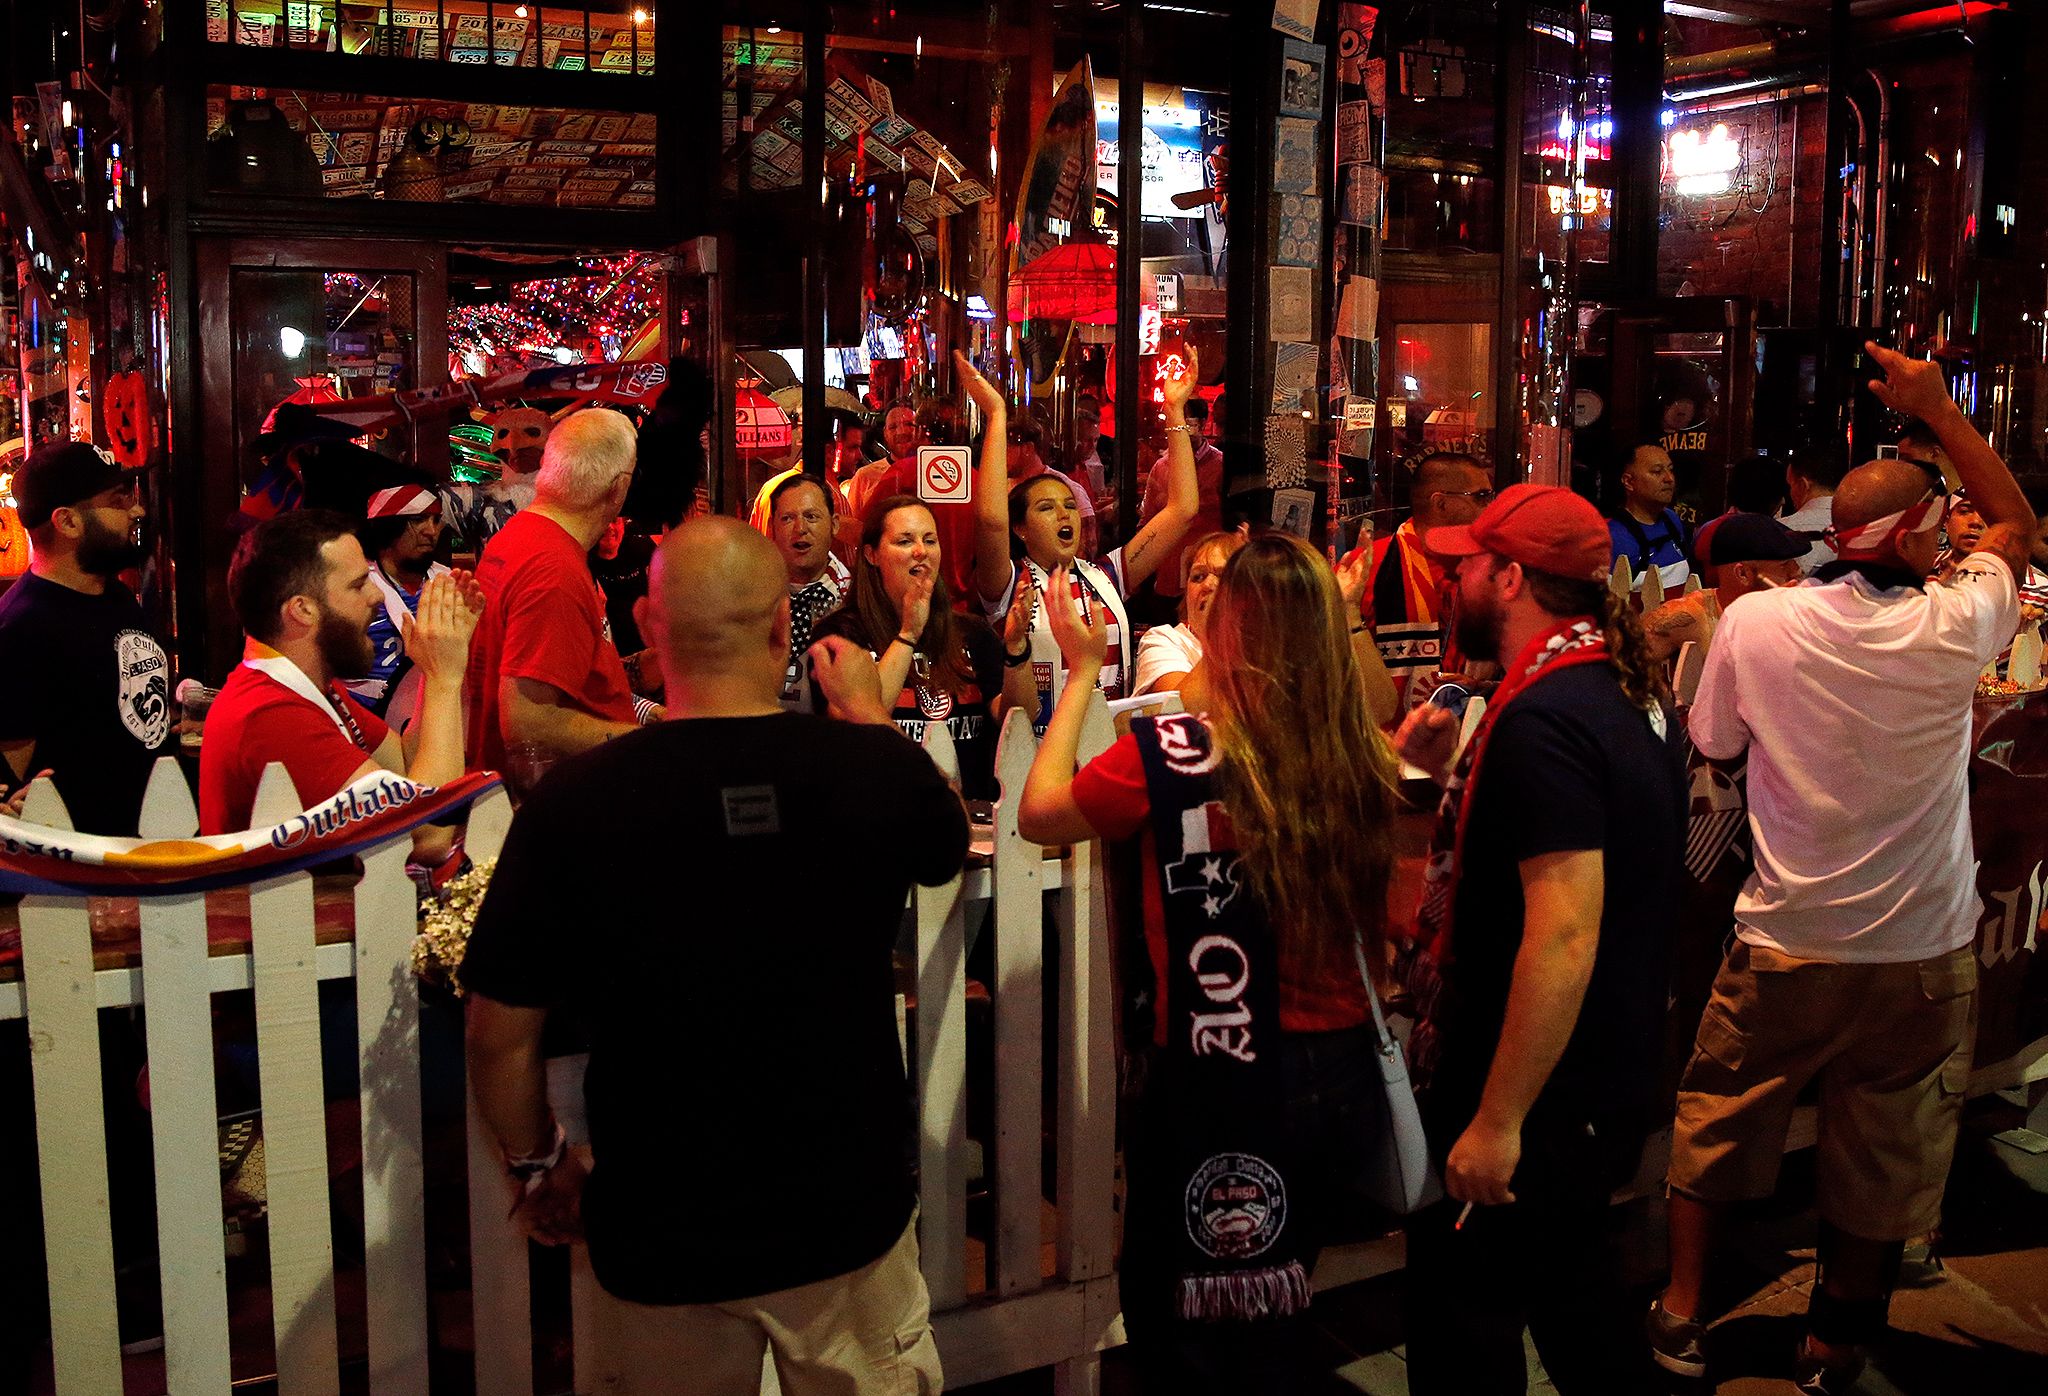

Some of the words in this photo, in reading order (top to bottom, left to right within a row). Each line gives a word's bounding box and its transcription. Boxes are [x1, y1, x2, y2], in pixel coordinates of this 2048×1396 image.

[1407, 641, 1437, 656] AO
[137, 656, 160, 674] PASO
[1211, 1187, 1226, 1200] EL
[1227, 1185, 1258, 1200] PASO
